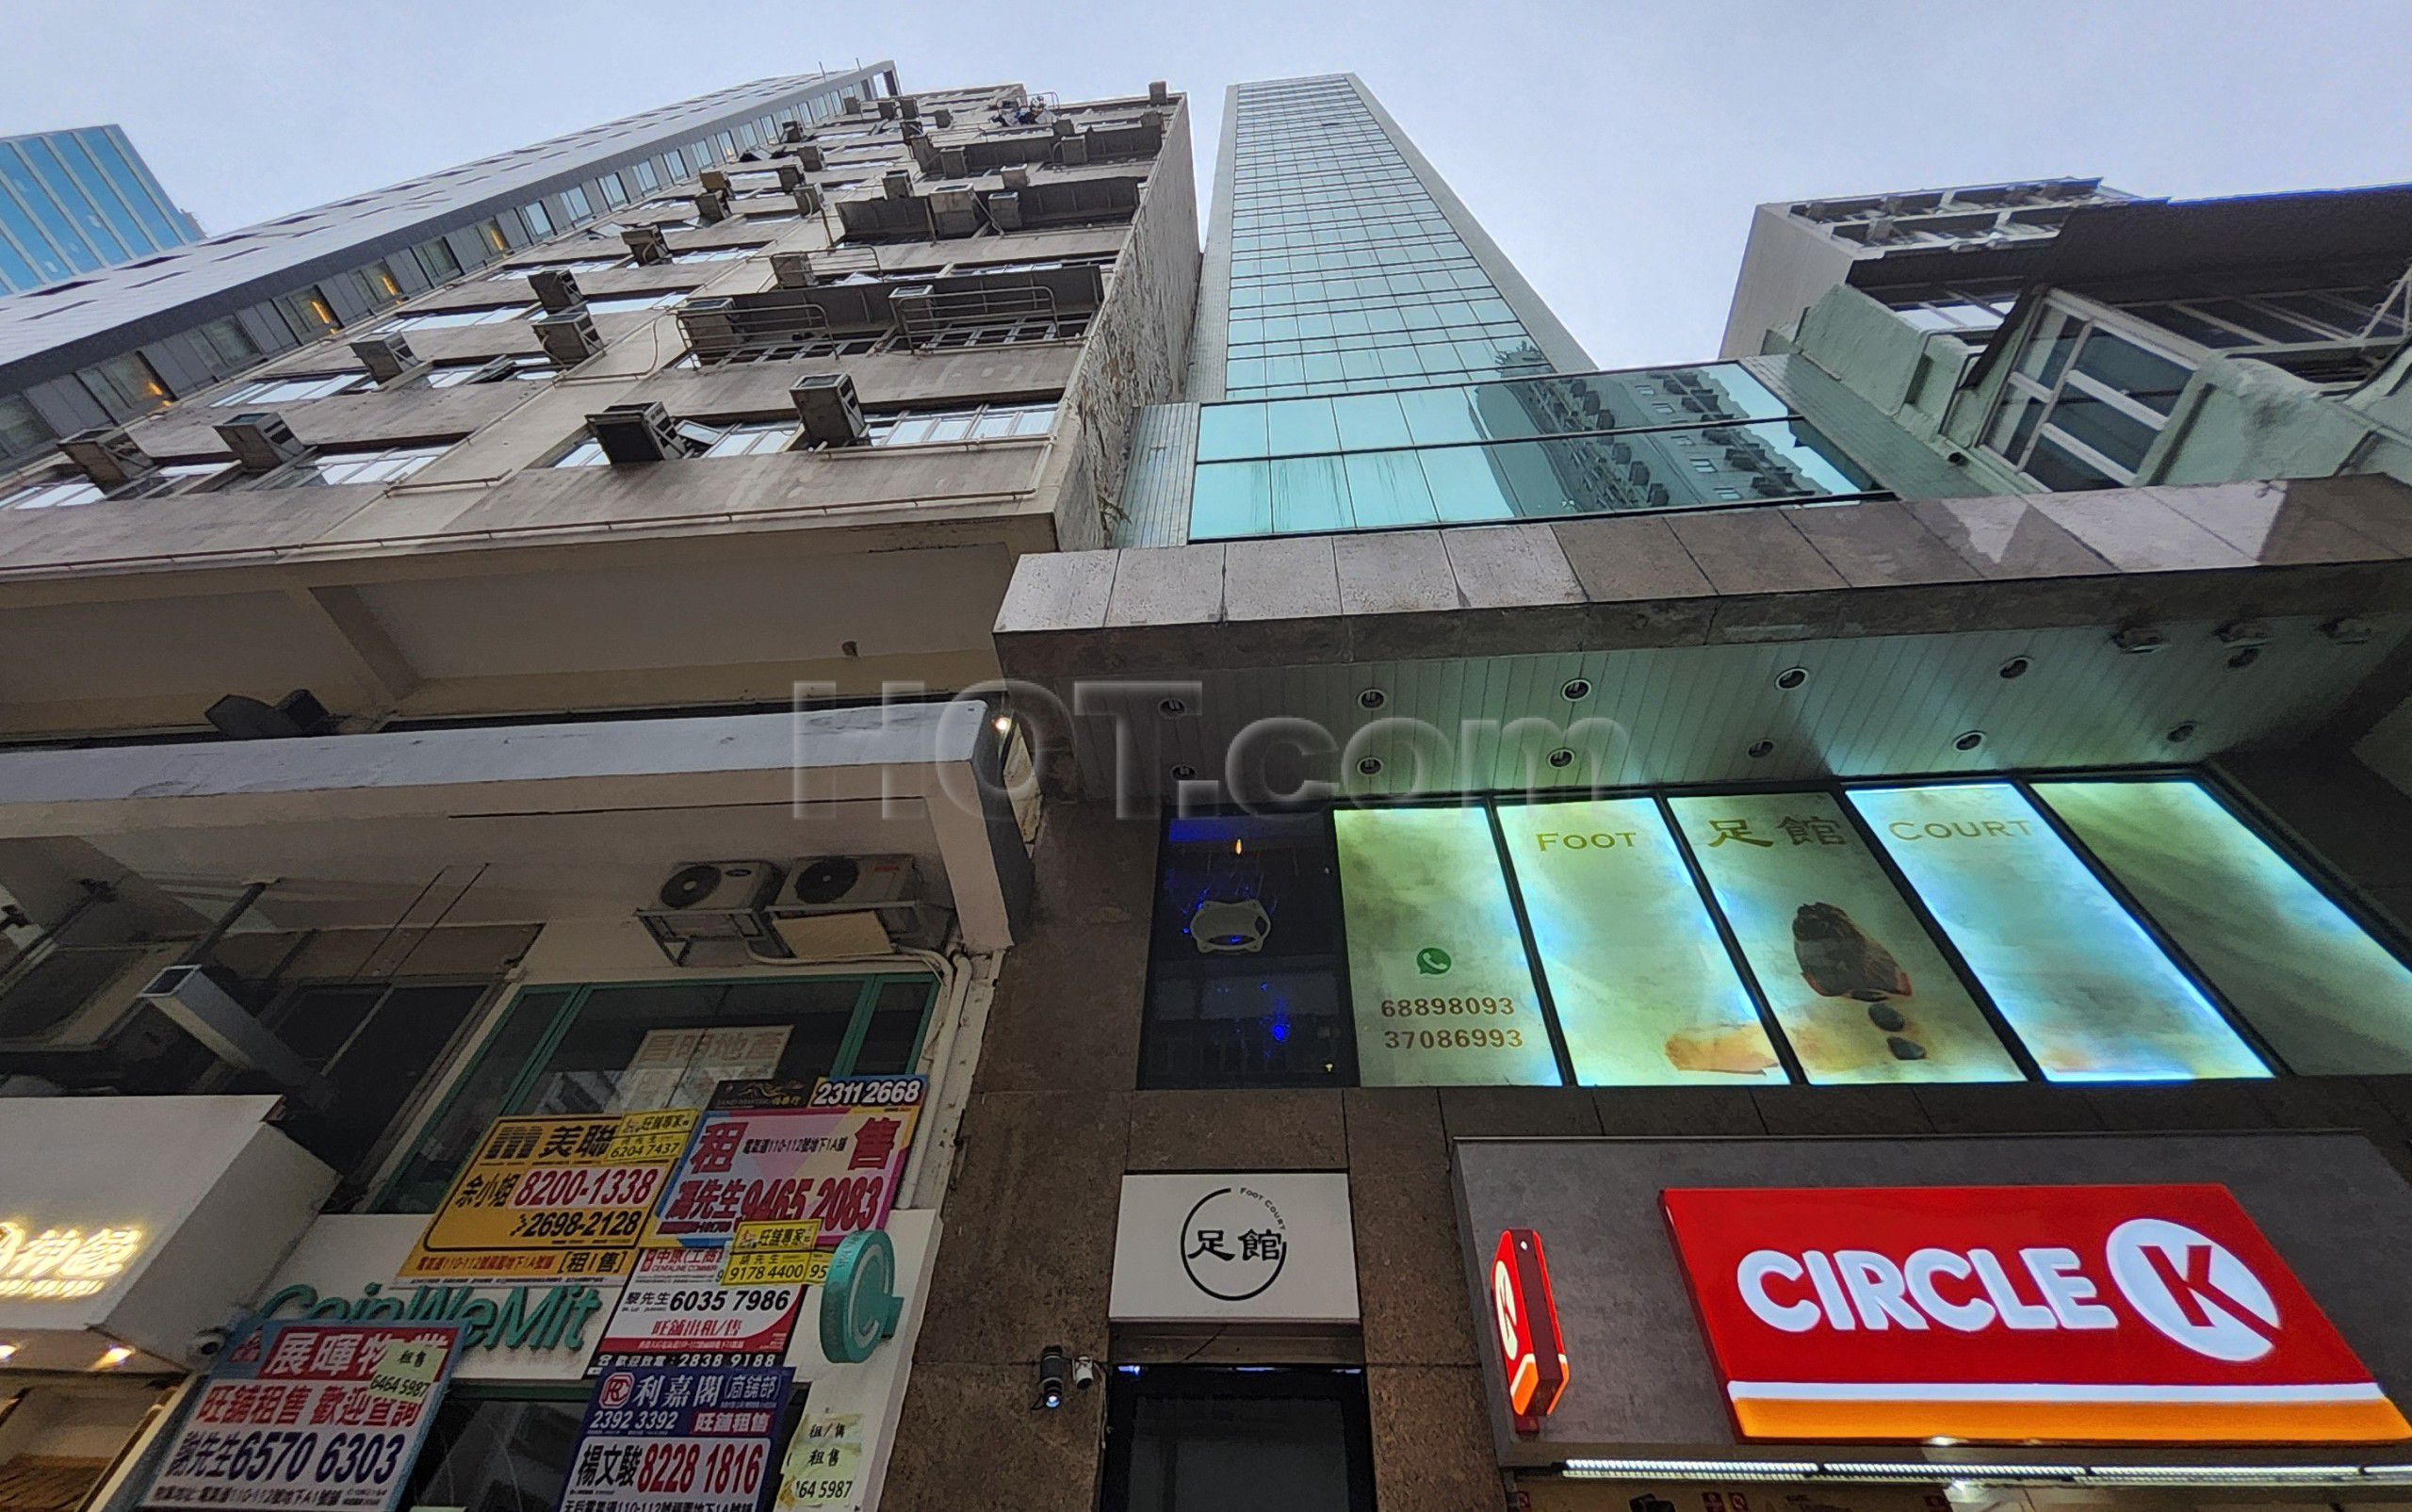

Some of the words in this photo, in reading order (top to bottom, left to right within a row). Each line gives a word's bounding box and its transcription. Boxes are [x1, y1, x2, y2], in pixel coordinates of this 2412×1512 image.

[1537, 831, 1638, 852] FOOT
[1707, 817, 1850, 849] 足館
[1888, 820, 2032, 841] COURT
[1381, 997, 1515, 1018] 68898093
[1384, 1029, 1524, 1049] 37086993
[538, 1125, 620, 1158] 美聯
[690, 1121, 749, 1175] 租
[848, 1116, 902, 1170] 售
[514, 1168, 659, 1206] 8200-1338
[1239, 1187, 1264, 1201] FOOT
[809, 1177, 884, 1231] 2083
[522, 1211, 643, 1238] 2698-2128
[1187, 1228, 1282, 1261] 足館
[729, 1266, 764, 1281] 9178
[768, 1264, 805, 1278] 4400
[669, 1290, 727, 1312] 6035
[731, 1290, 791, 1312] 7986
[1737, 1247, 2118, 1332] CIRCLE
[2131, 1236, 2280, 1353] K
[678, 1354, 724, 1367] 2838
[730, 1354, 776, 1367] 9188
[590, 1410, 633, 1430] 2392
[633, 1410, 679, 1430] 3392
[228, 1431, 318, 1482] 6570
[315, 1432, 405, 1484] 6303
[636, 1442, 701, 1493] 8228
[704, 1442, 764, 1495] 1816
[818, 1480, 854, 1499] 5987
